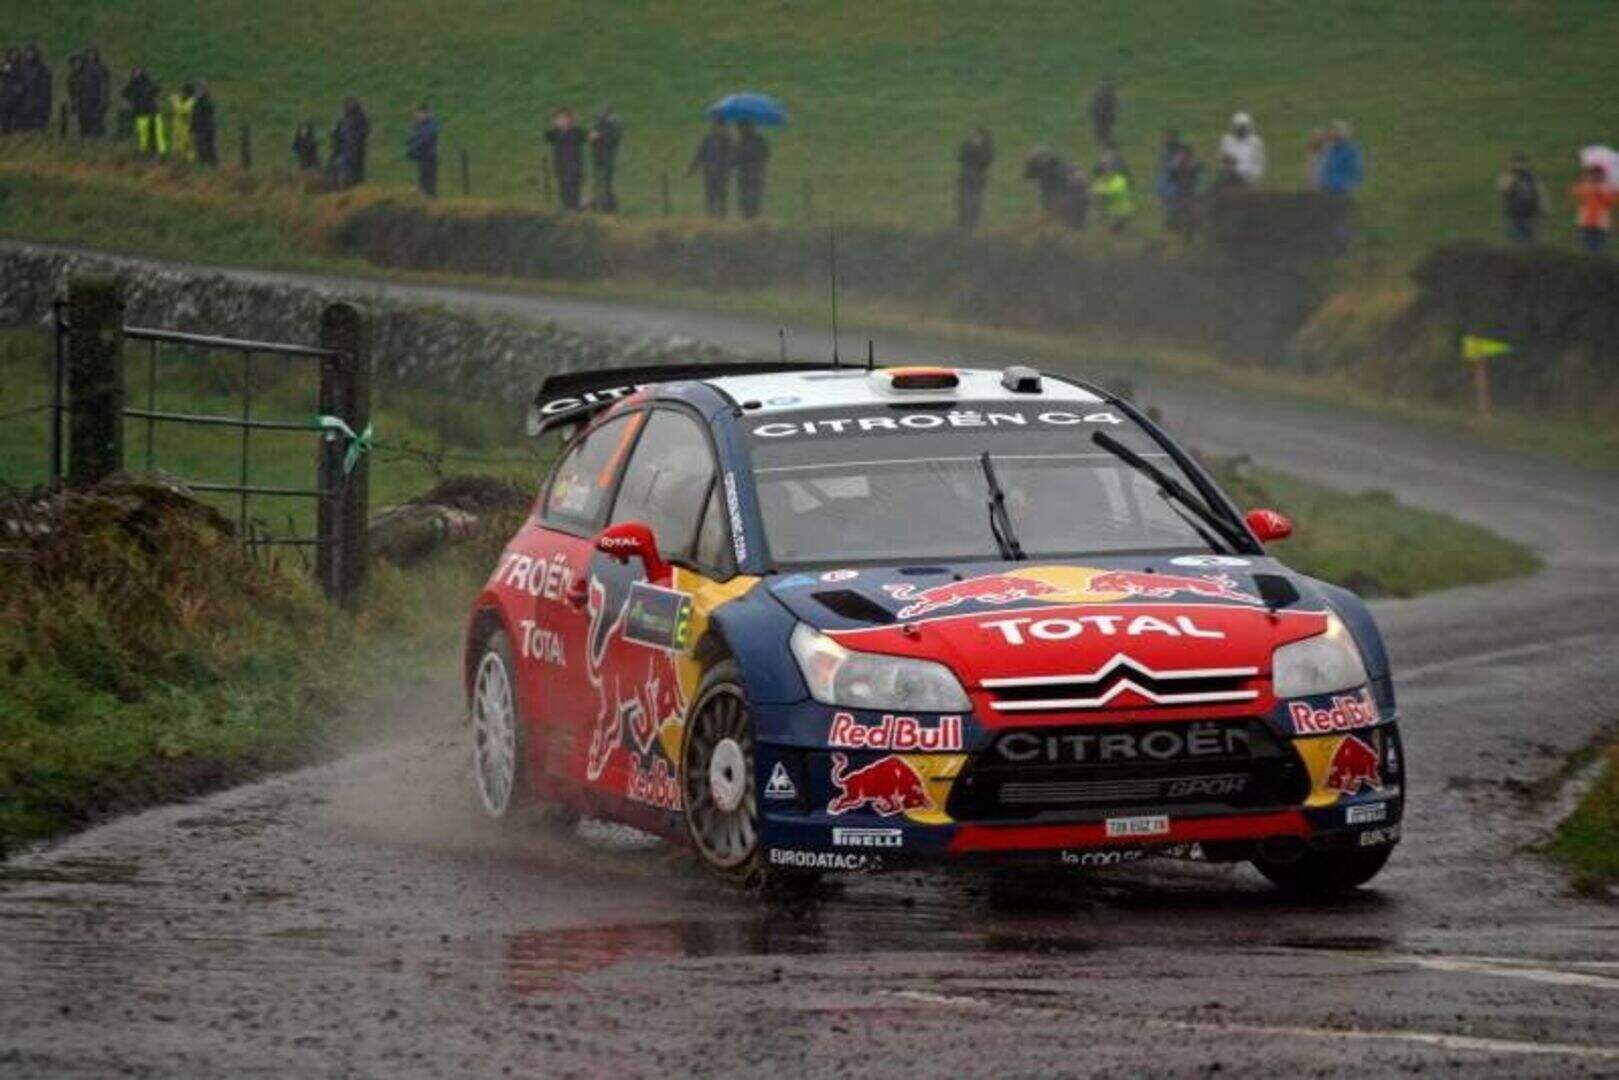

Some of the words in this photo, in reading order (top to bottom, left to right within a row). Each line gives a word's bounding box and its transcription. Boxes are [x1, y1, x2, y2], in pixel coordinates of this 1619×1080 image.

[753, 410, 1027, 437] CITROËN
[1038, 411, 1123, 426] C4
[601, 536, 641, 549] TOTAL
[981, 615, 1225, 646] TOTAL
[832, 827, 903, 846] PIRELLI
